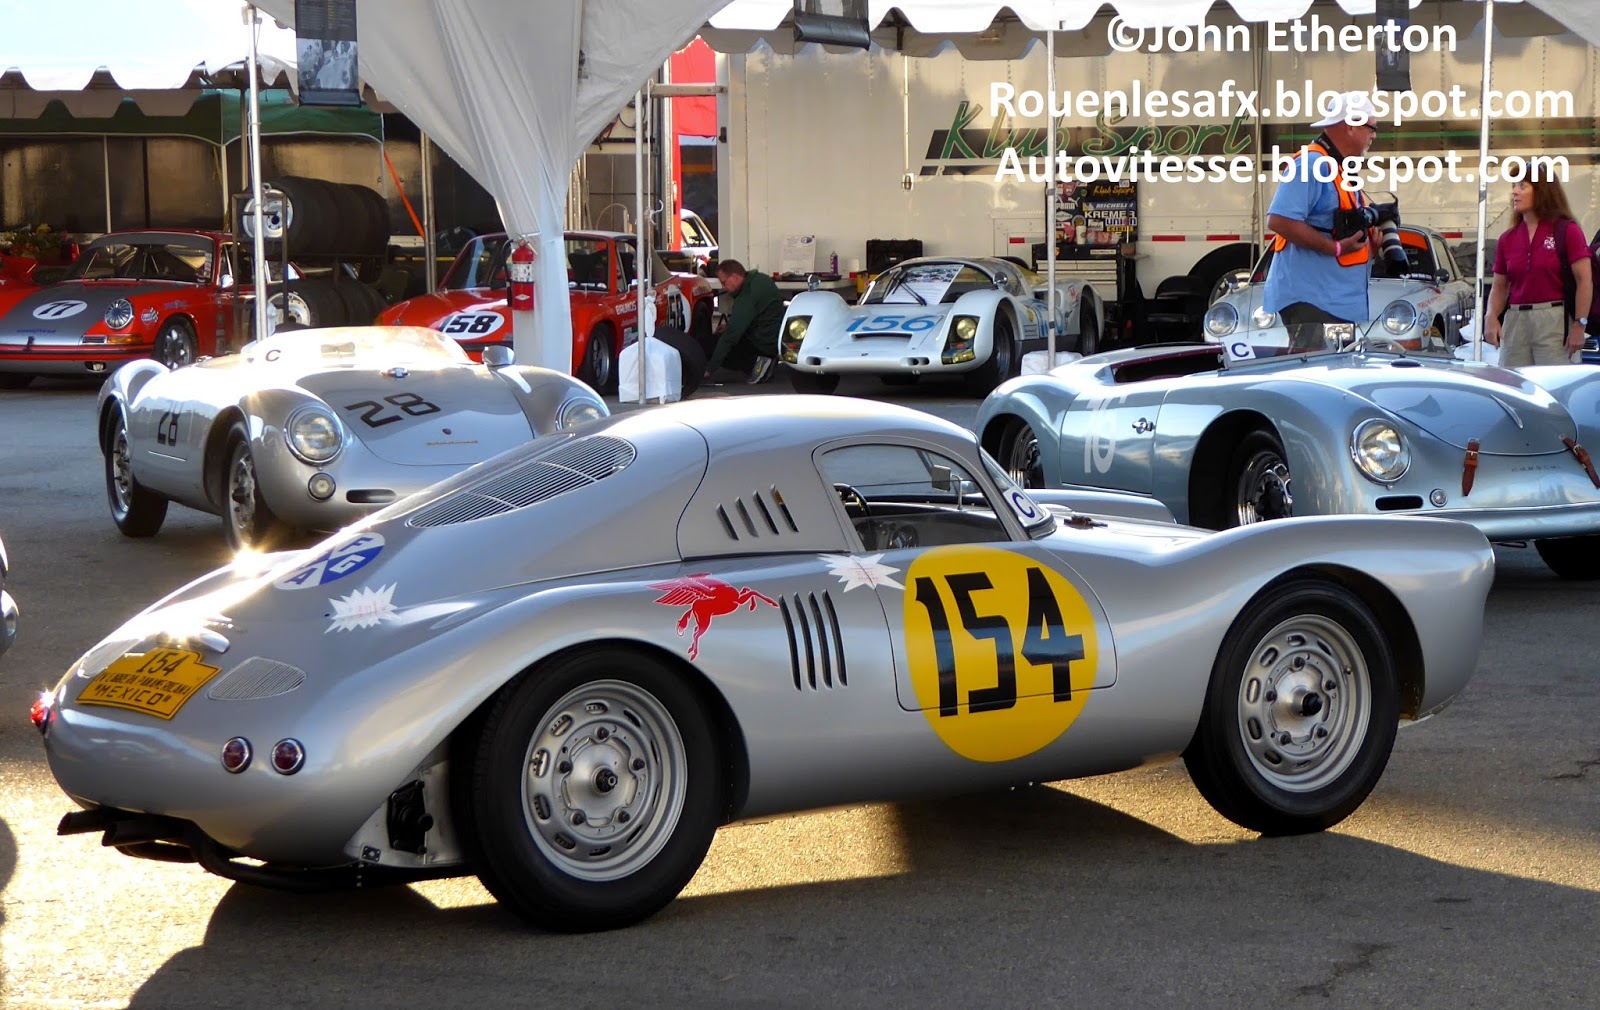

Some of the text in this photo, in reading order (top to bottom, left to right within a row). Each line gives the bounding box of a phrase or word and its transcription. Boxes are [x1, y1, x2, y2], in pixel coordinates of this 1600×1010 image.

[941, 100, 1253, 173] Klub Sport
[40, 302, 83, 317] 77
[846, 314, 939, 332] 156
[265, 349, 281, 362] C
[1231, 342, 1250, 358] C
[344, 392, 441, 428] 28
[1011, 491, 1036, 518] C
[915, 567, 1085, 718] 154
[135, 651, 189, 676] 154
